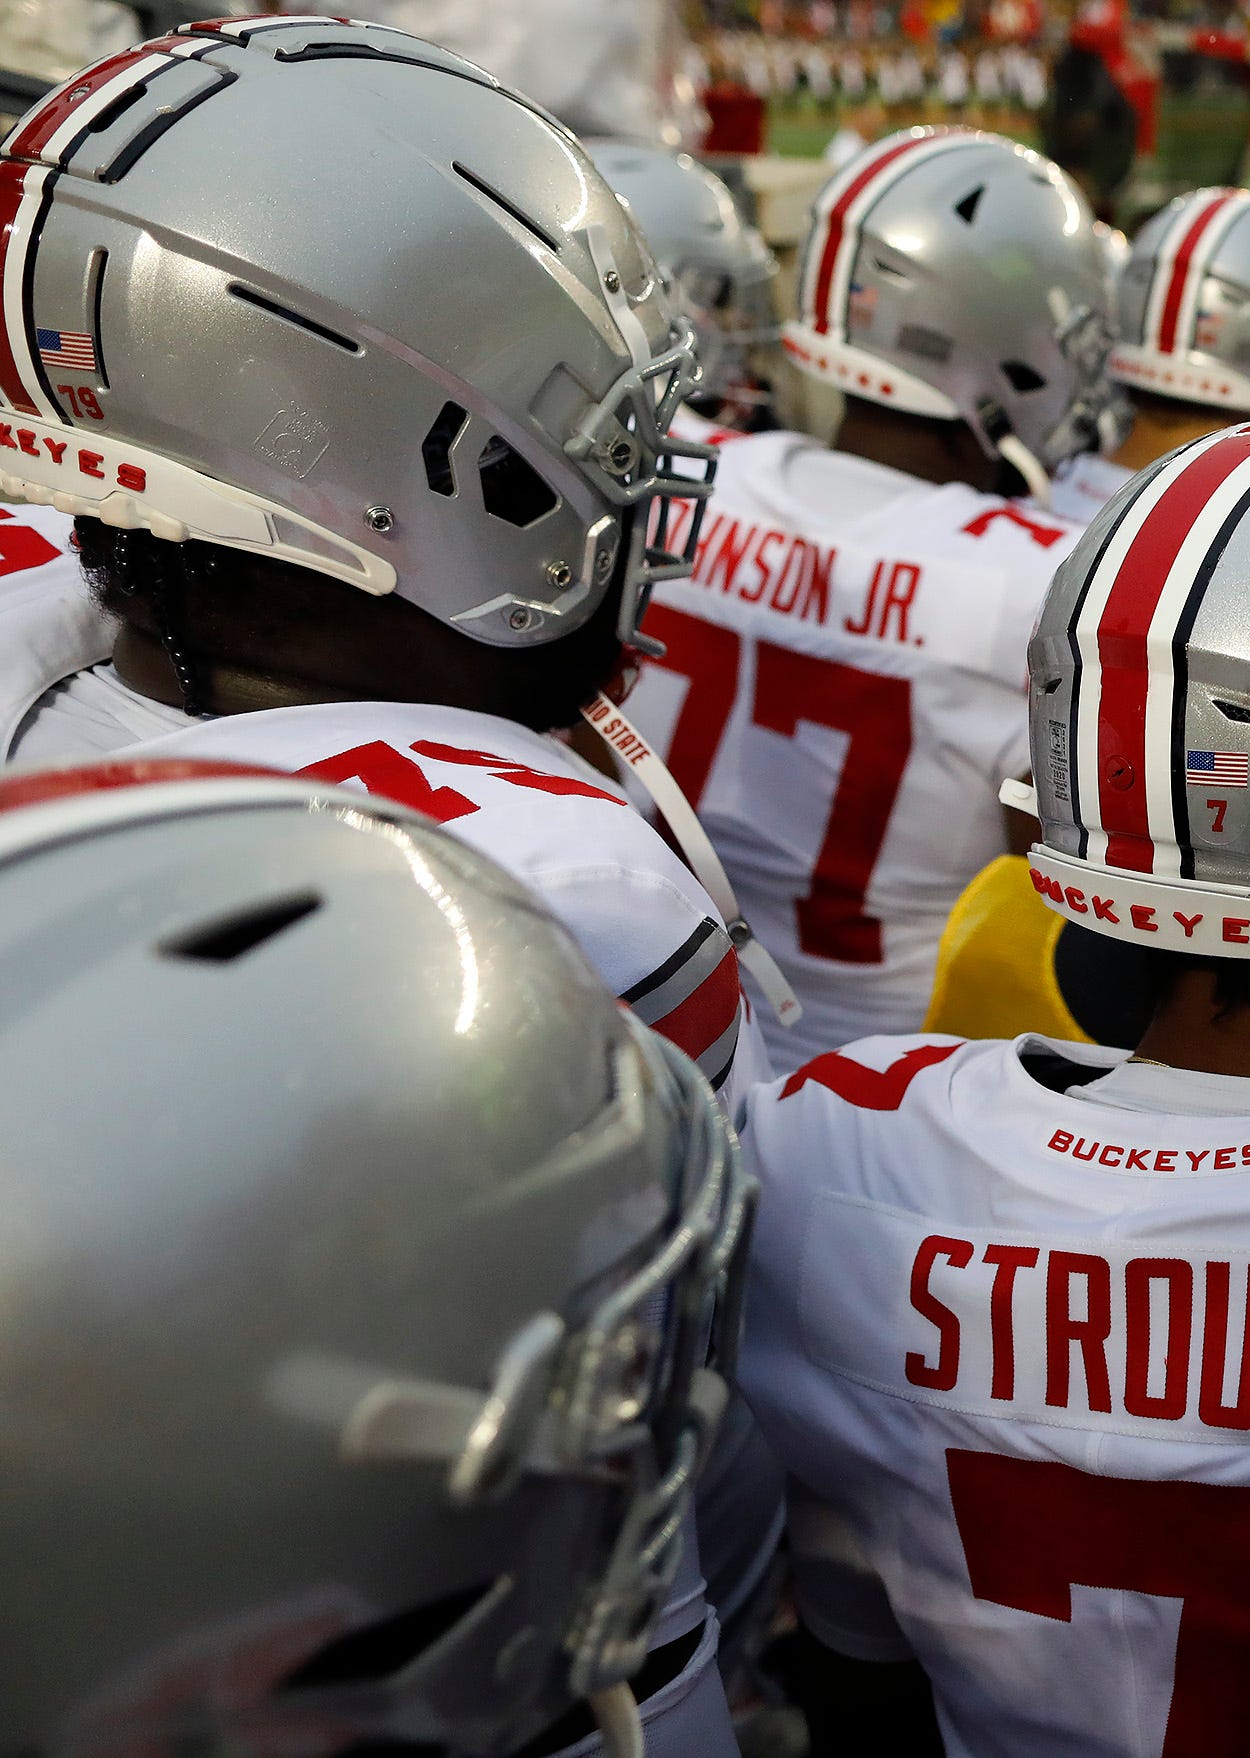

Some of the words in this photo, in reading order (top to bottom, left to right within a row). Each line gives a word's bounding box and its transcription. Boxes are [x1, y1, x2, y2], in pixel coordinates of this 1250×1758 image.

[57, 384, 105, 420] 79
[645, 494, 837, 627] OHNSON
[843, 560, 925, 647] JR.
[603, 718, 651, 766] STATE
[1206, 799, 1228, 833] 7
